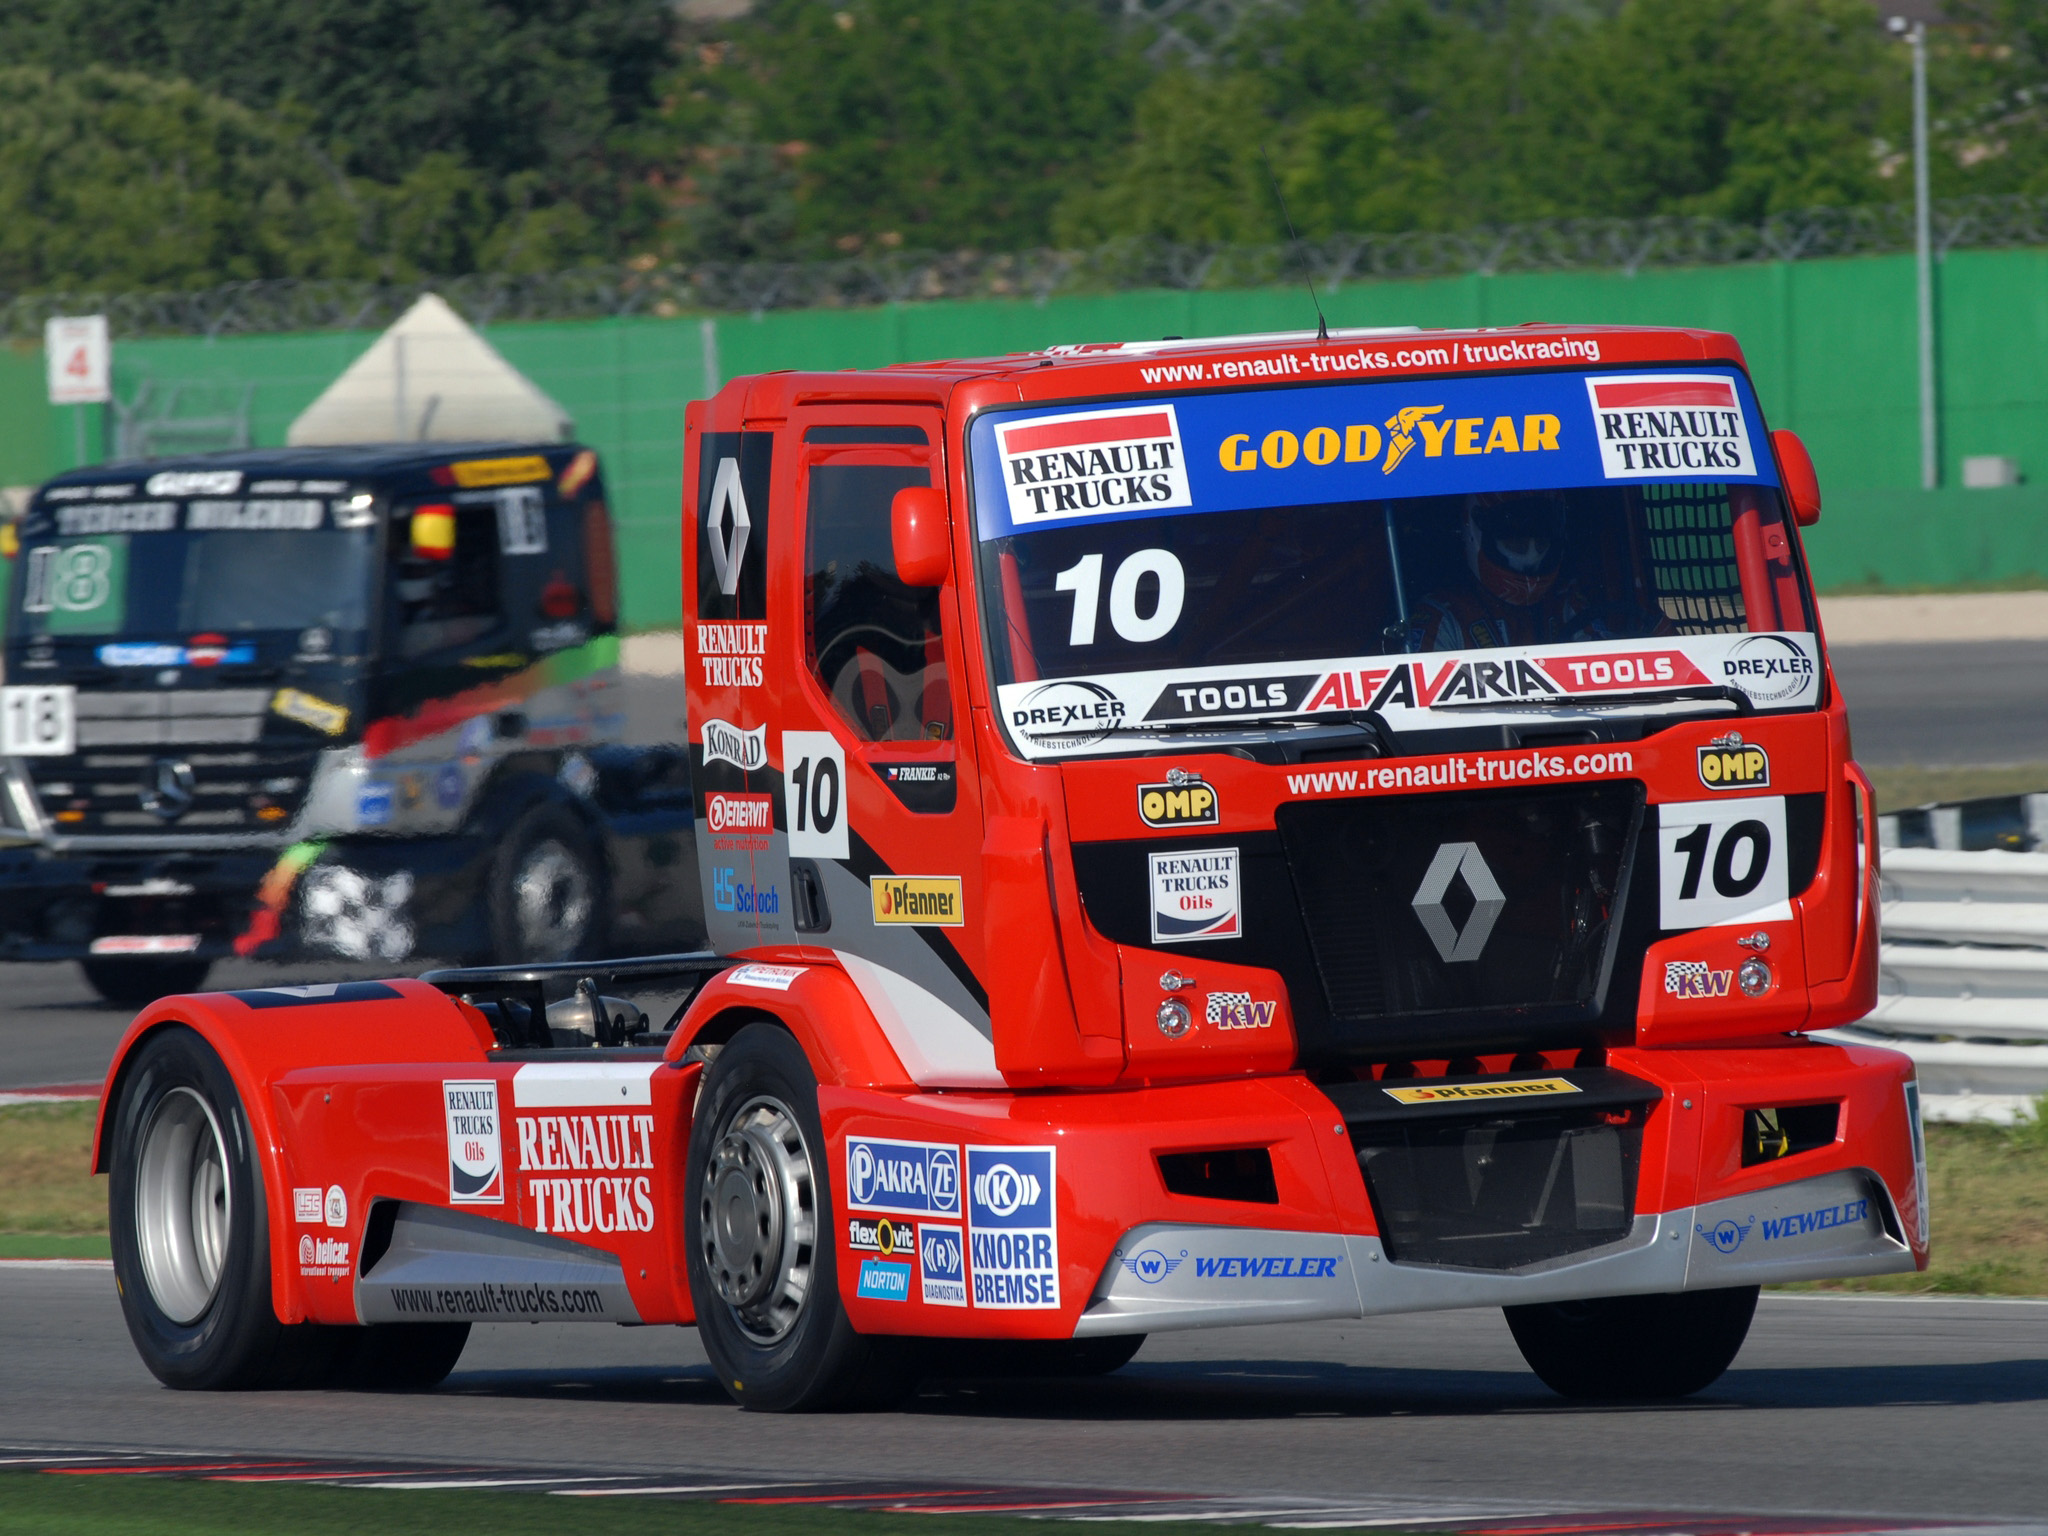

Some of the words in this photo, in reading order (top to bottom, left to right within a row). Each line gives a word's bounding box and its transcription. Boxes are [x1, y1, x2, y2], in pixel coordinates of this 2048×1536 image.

[64, 345, 90, 377] 4
[1141, 348, 1449, 384] www.renault-trucks.com
[1463, 337, 1600, 361] truckracing
[1601, 411, 1740, 440] RENAULT
[1009, 441, 1175, 486] RENAULT
[1617, 441, 1742, 470] TRUCKS
[1026, 473, 1173, 514] TRUCKS
[22, 544, 112, 613] 18
[1055, 548, 1185, 646] 10
[697, 624, 767, 655] RENAULT
[702, 656, 764, 687] TRUCKS
[1723, 658, 1813, 678] DREXLER
[1176, 683, 1288, 712] TOOLS
[1305, 659, 1560, 711] ALFAVARIA
[1568, 657, 1675, 685] TOOLS
[9, 693, 63, 744] 18
[1013, 701, 1126, 727] DREXLER
[707, 723, 761, 767] KONRAD
[898, 767, 937, 781] FRANKIE
[1287, 751, 1633, 794] www.renault-trucks.com
[1701, 751, 1765, 782] OMP
[791, 756, 840, 834] 10
[1143, 788, 1213, 820] OMP
[714, 835, 734, 850] active
[1156, 856, 1233, 876] RENAULT
[1673, 819, 1772, 901] 10
[1162, 875, 1229, 893] TRUCKS
[893, 885, 954, 916] Pfanner
[1179, 895, 1213, 912] Oils
[1677, 970, 1733, 999] KW
[1218, 1001, 1276, 1031] KW
[447, 1090, 494, 1111] RENAULT
[1434, 1082, 1559, 1098] Pfanner
[452, 1115, 494, 1136] TRUCKS
[464, 1140, 486, 1162] Oils
[515, 1114, 654, 1171] RENAULT
[853, 1148, 928, 1199] PAKRA
[932, 1163, 955, 1198] ZF
[529, 1176, 654, 1233] TRUCKS
[1762, 1199, 1868, 1241] WEWELER
[971, 1233, 1053, 1270] KNORR
[863, 1271, 905, 1291] NORTON
[1196, 1258, 1337, 1277] WEWELER
[391, 1283, 603, 1315] www.renault-trucks.com
[924, 1284, 965, 1301] DIAGNOSTIKA
[974, 1274, 1055, 1304] BREMSE
